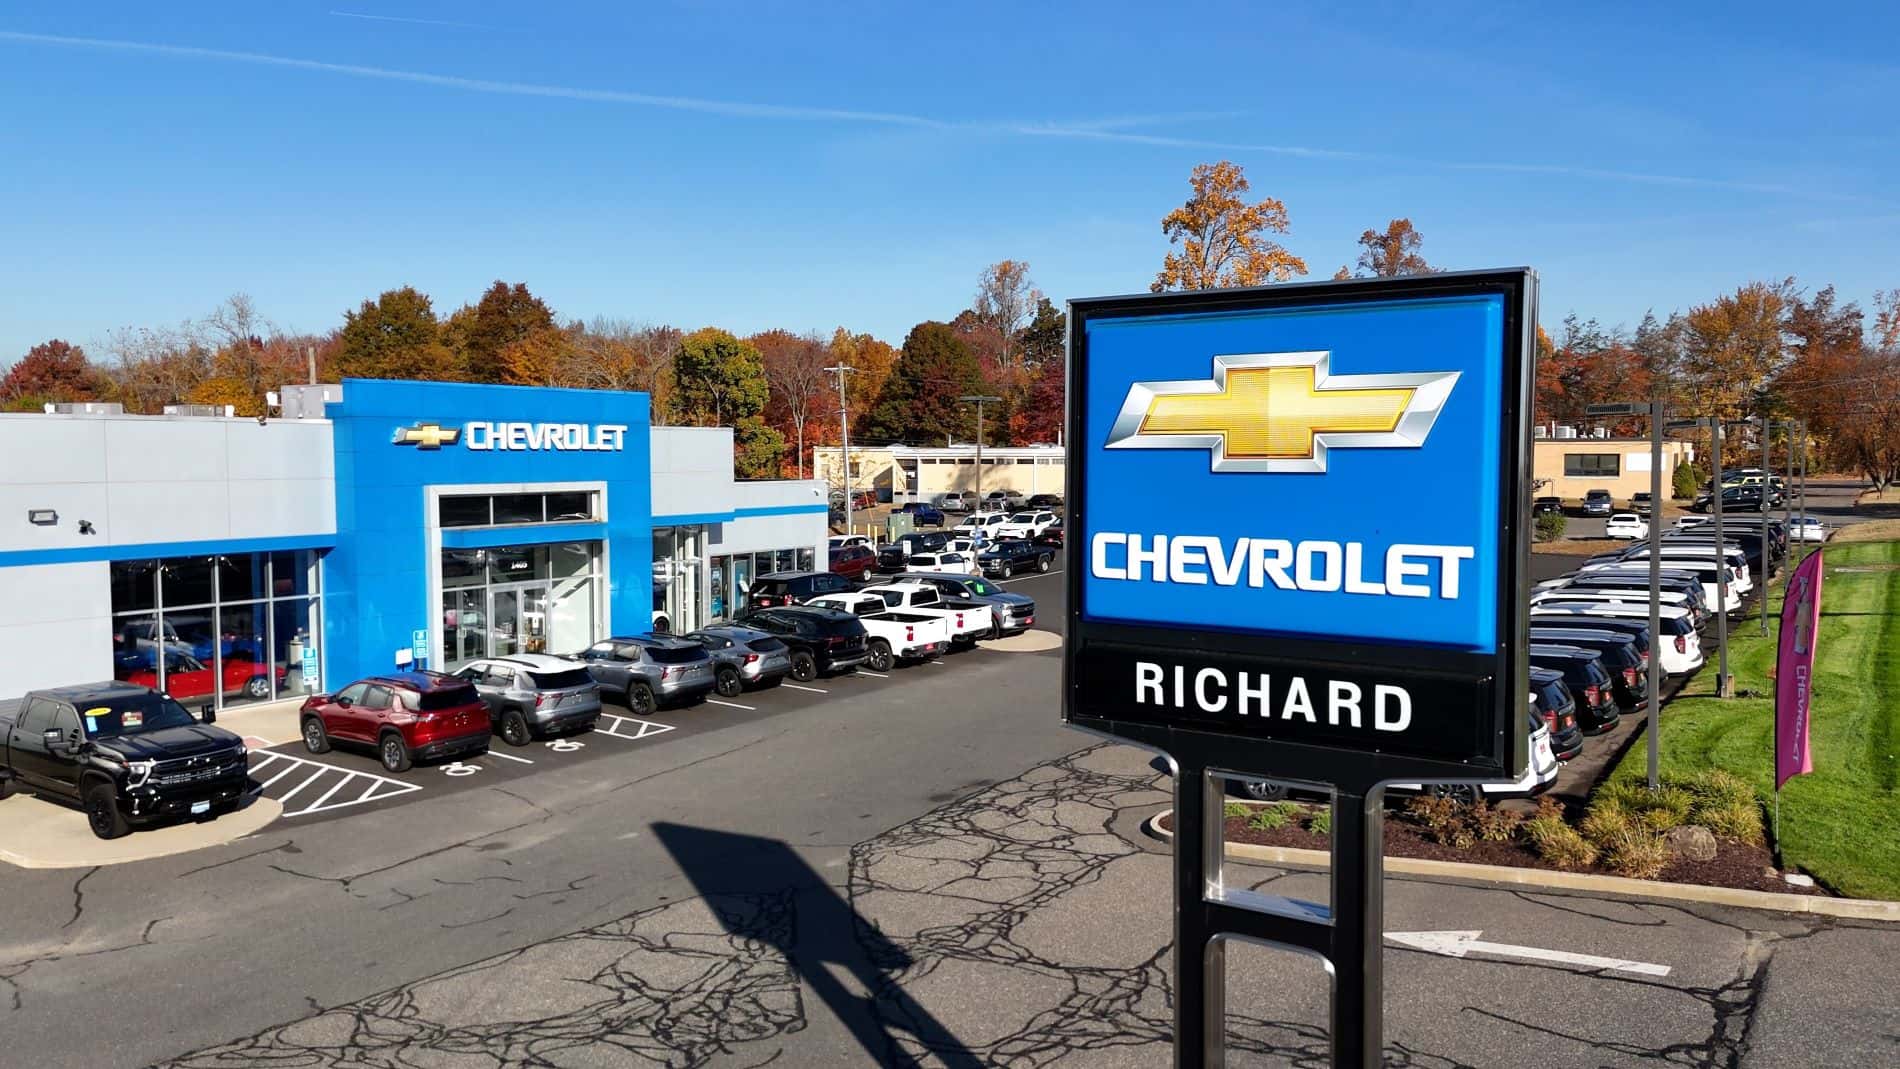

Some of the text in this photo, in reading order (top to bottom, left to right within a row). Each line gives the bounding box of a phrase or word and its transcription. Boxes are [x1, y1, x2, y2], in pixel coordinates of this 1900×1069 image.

[466, 421, 628, 451] CHEVROLET
[1091, 531, 1475, 599] CHEVROLET
[1135, 661, 1412, 732] RICHARD
